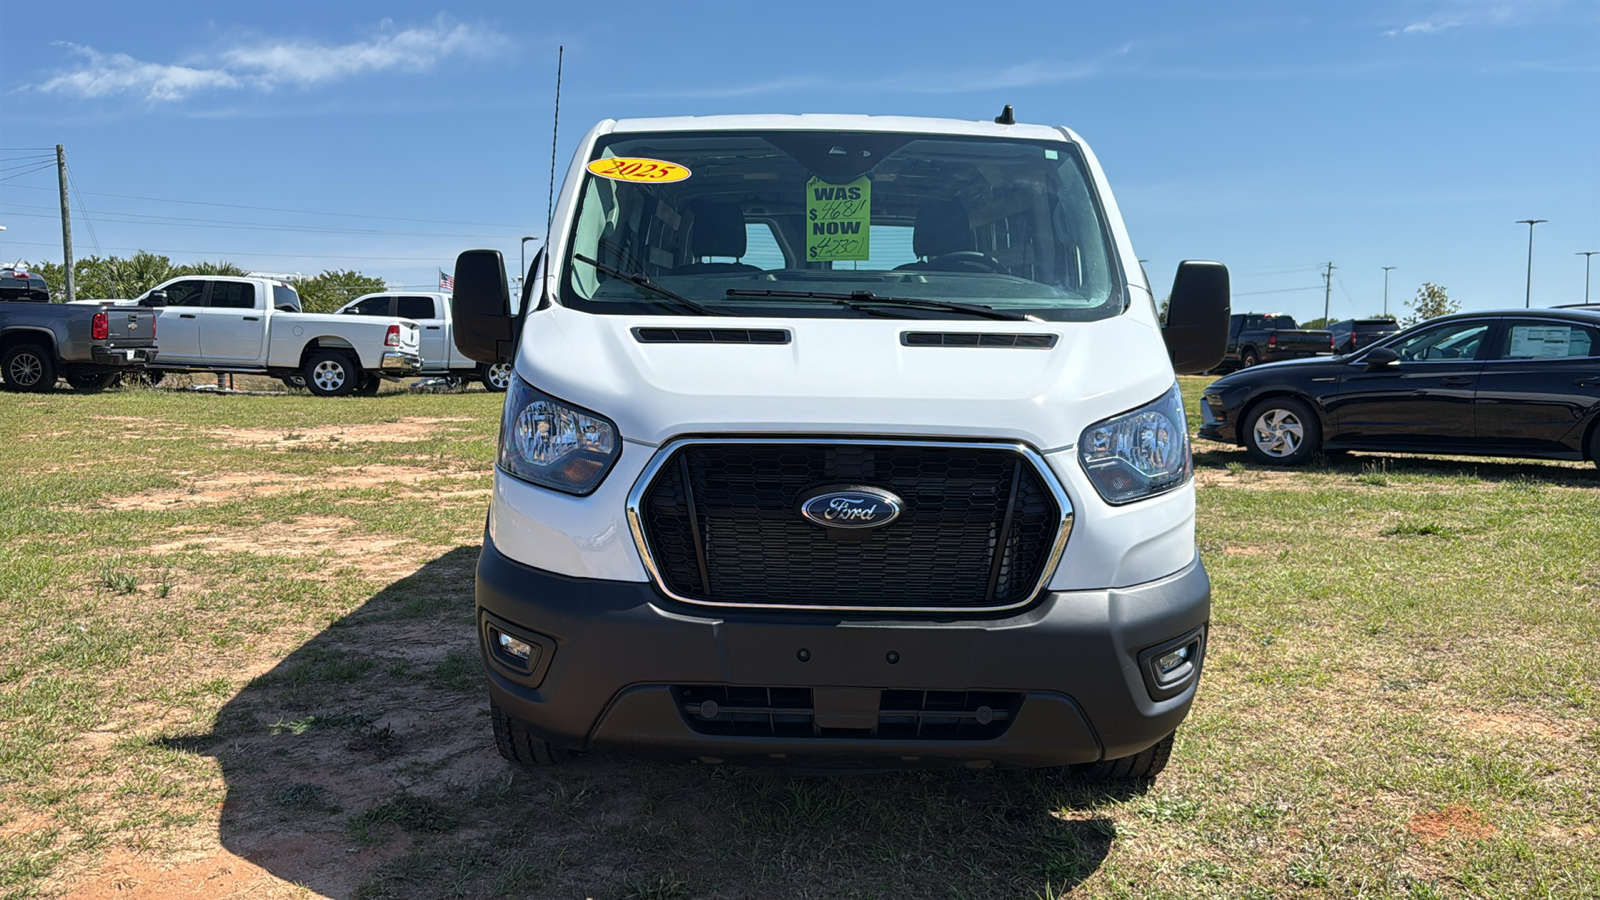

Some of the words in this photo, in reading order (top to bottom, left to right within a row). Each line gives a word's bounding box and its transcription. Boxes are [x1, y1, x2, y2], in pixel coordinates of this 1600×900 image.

[600, 160, 676, 179] 2025
[814, 187, 861, 201] WAS
[813, 221, 861, 235] NOW
[824, 497, 877, 521] Ford
